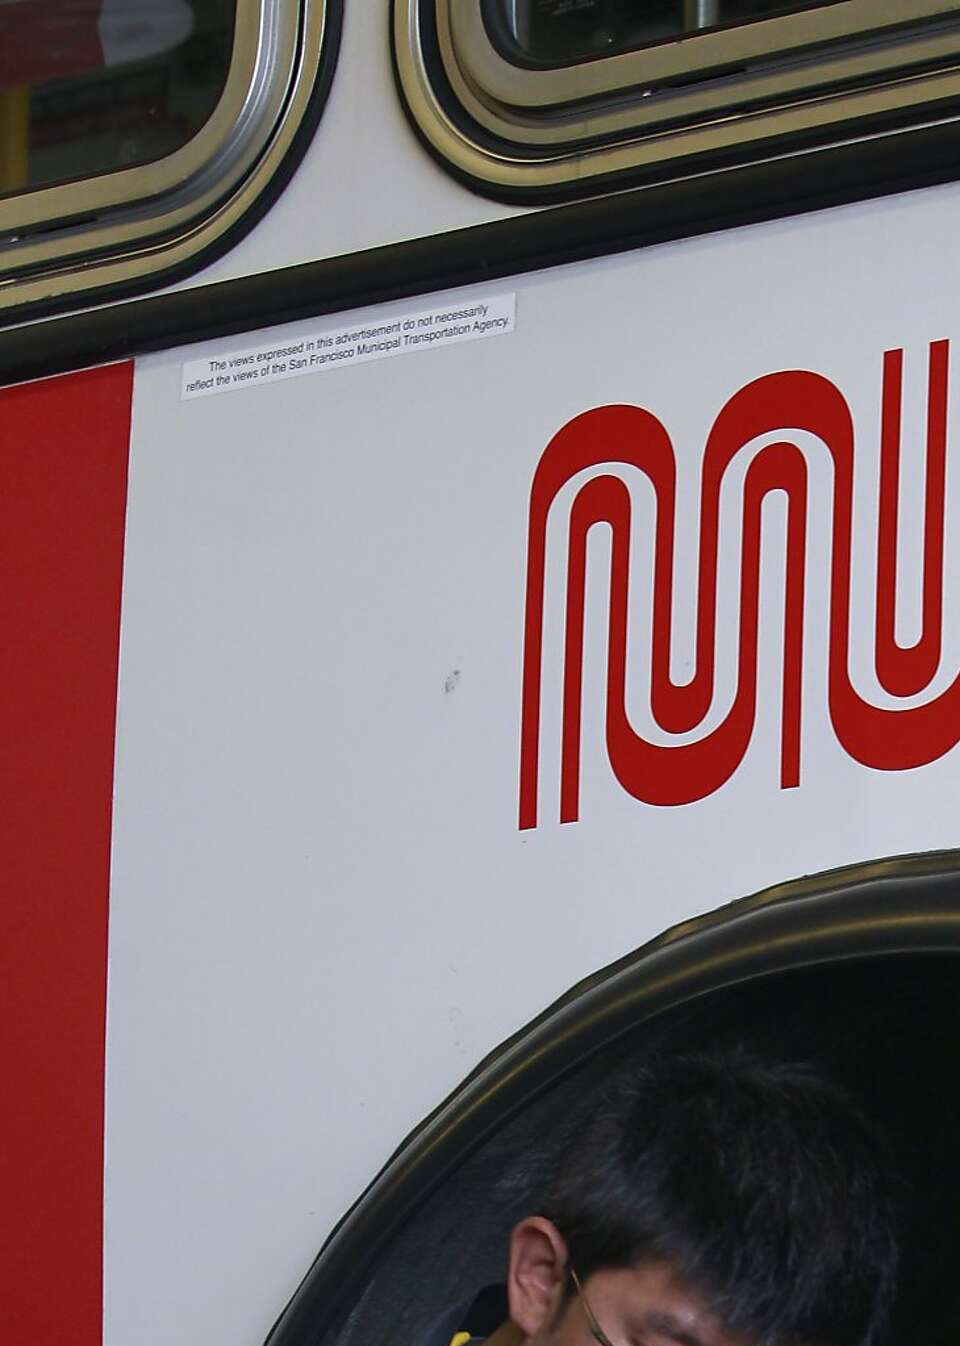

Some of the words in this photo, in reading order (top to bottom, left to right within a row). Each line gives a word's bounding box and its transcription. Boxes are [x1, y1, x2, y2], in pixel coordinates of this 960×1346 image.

[186, 377, 214, 392] reflect
[215, 374, 230, 386] the
[232, 370, 259, 382] views
[260, 365, 270, 377] of
[271, 362, 287, 374] the
[289, 358, 307, 370] San
[309, 348, 354, 366] Francisco
[357, 337, 401, 355] Municipal
[404, 323, 470, 345] Transportation
[208, 361, 227, 372] The
[228, 357, 254, 368] views
[256, 343, 304, 362] expressed
[306, 341, 315, 351] in
[316, 337, 333, 349] this
[335, 322, 401, 345] advertisement
[402, 319, 415, 331] do
[417, 316, 433, 328] not
[435, 304, 489, 324] necessarily
